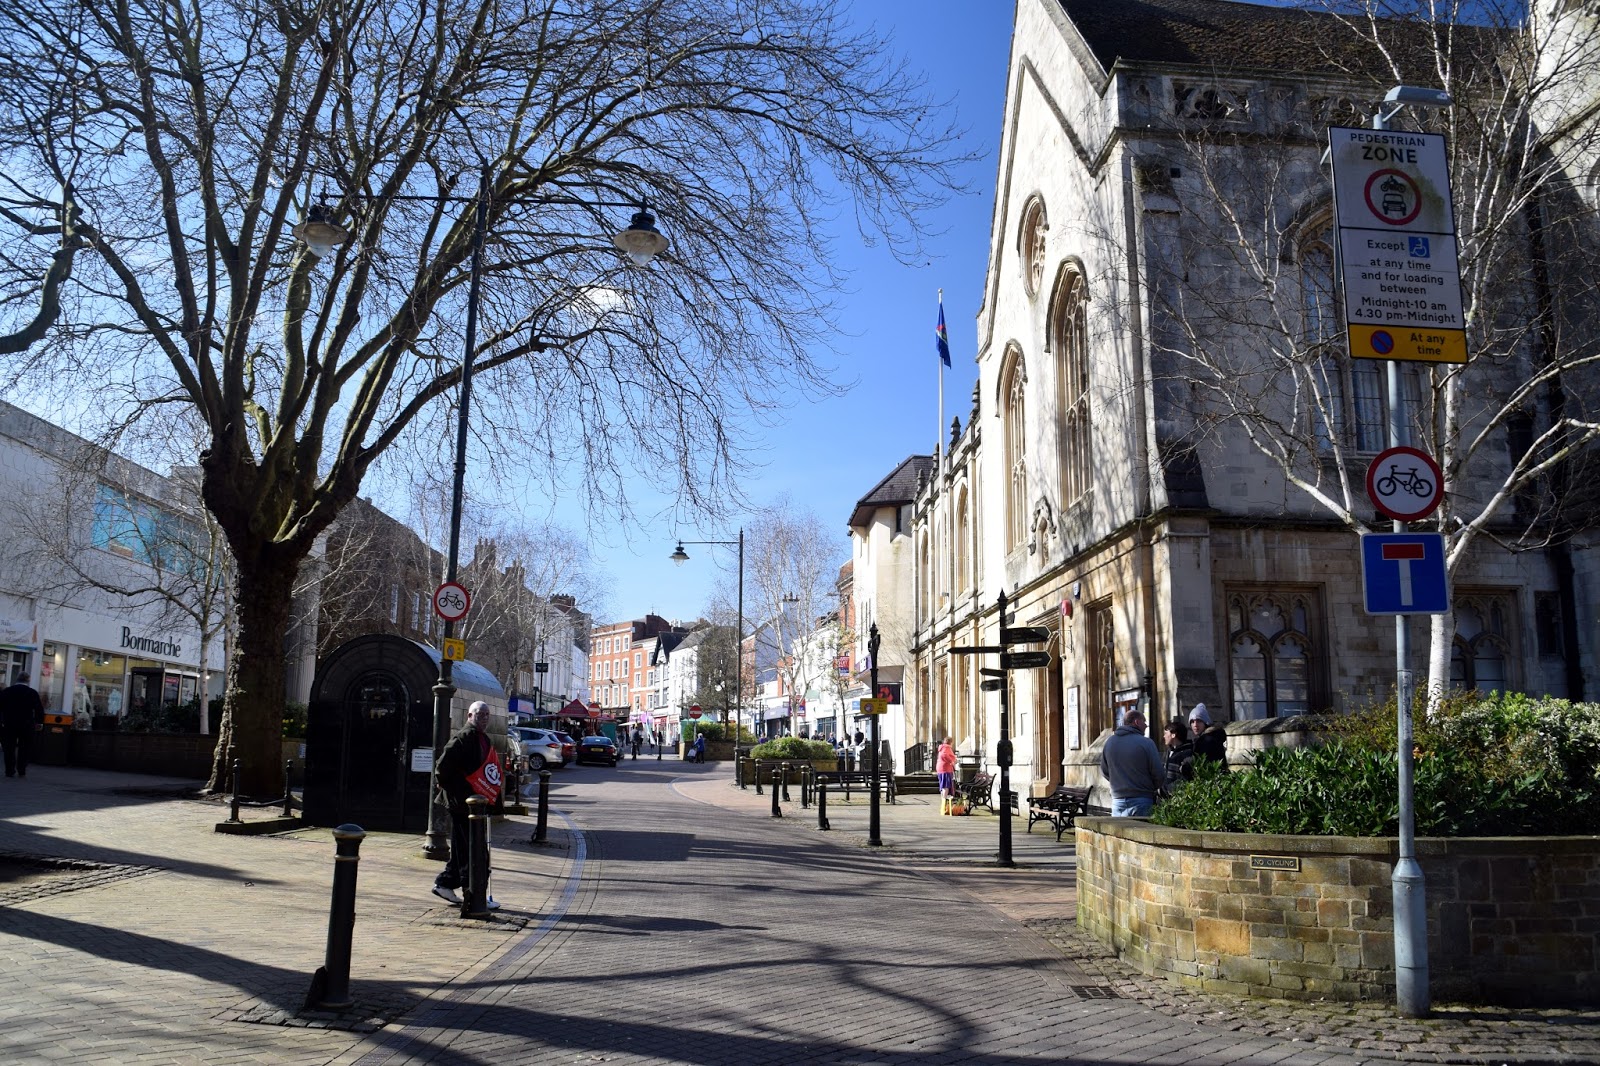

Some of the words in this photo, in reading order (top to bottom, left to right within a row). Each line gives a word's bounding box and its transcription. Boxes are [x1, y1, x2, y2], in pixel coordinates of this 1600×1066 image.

[1351, 133, 1425, 146] PEDESTRIAN
[1362, 146, 1417, 163] ZONE
[1367, 239, 1405, 251] Except
[1385, 260, 1403, 269] any
[1408, 261, 1431, 270] time
[1361, 271, 1380, 280] and
[1385, 272, 1400, 281] for
[1404, 273, 1444, 285] loading
[1380, 283, 1426, 294] between
[1431, 302, 1447, 311] am
[1355, 308, 1382, 318] 4.30
[1410, 333, 1423, 342] At
[1427, 335, 1445, 344] any
[1417, 345, 1441, 355] time
[120, 625, 181, 657] Bonmarché
